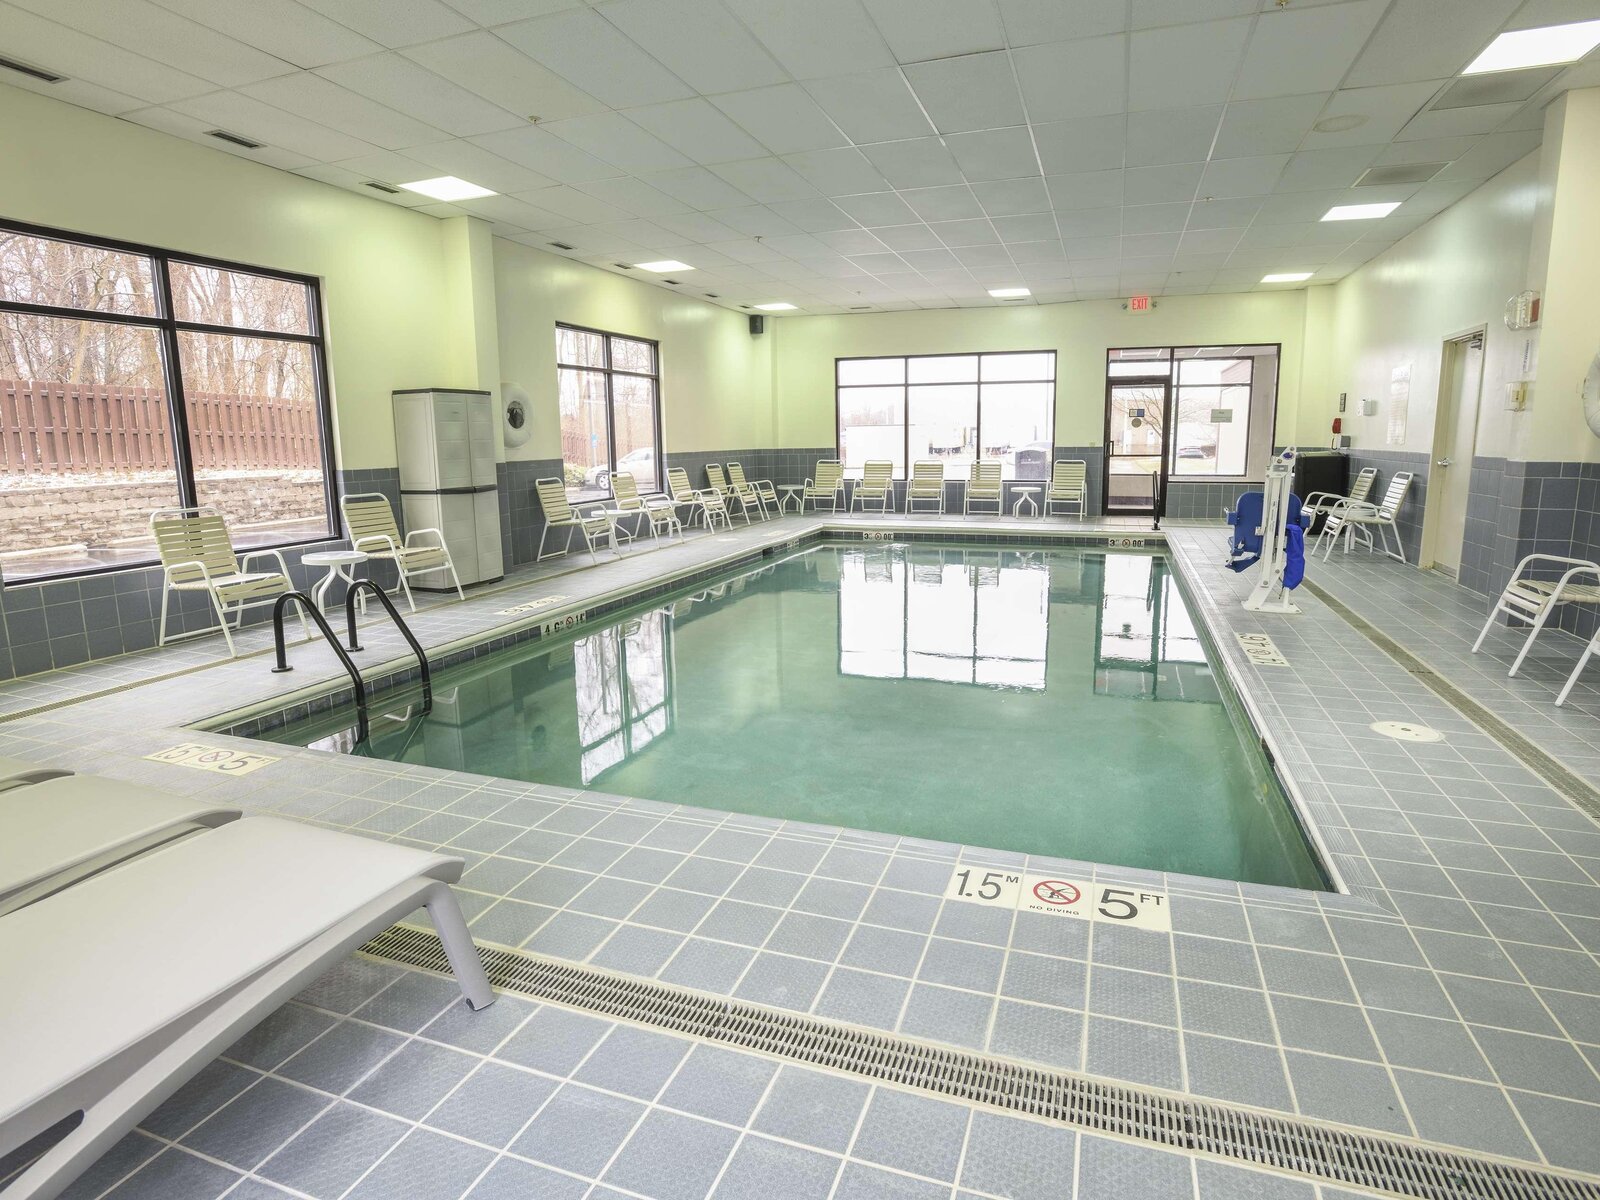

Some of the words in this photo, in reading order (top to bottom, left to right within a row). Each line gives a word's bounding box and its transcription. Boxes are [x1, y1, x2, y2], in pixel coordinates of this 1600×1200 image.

[1132, 296, 1148, 310] EXIT
[218, 755, 262, 771] 5
[957, 869, 1003, 900] 1.5
[1005, 875, 1019, 884] M
[1046, 907, 1080, 916] DIVING
[1098, 888, 1138, 920] 5
[1139, 893, 1164, 906] FT
